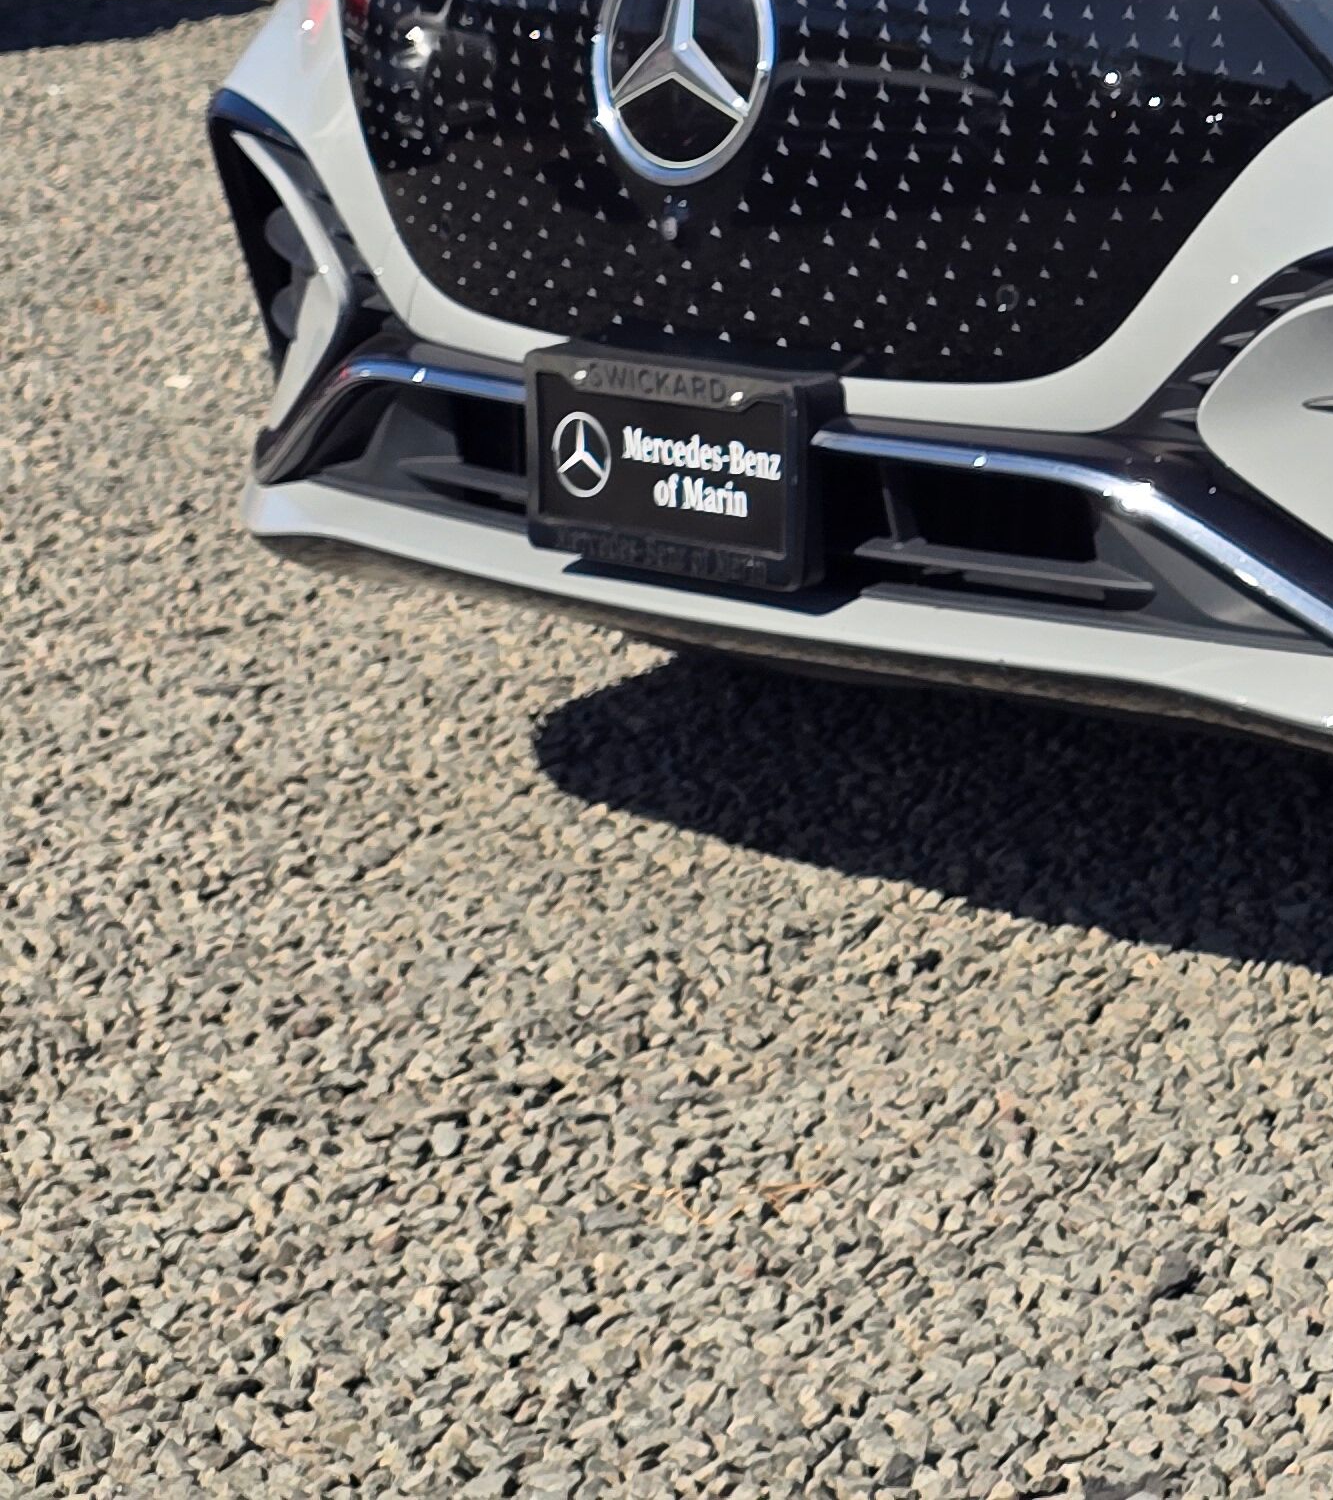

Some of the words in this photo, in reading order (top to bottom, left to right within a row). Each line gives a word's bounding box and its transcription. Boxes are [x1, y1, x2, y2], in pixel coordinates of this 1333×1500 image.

[588, 362, 728, 403] SWICKARD
[621, 425, 782, 481] Mercedes-Benz
[653, 473, 679, 508] of
[681, 476, 748, 518] Marin
